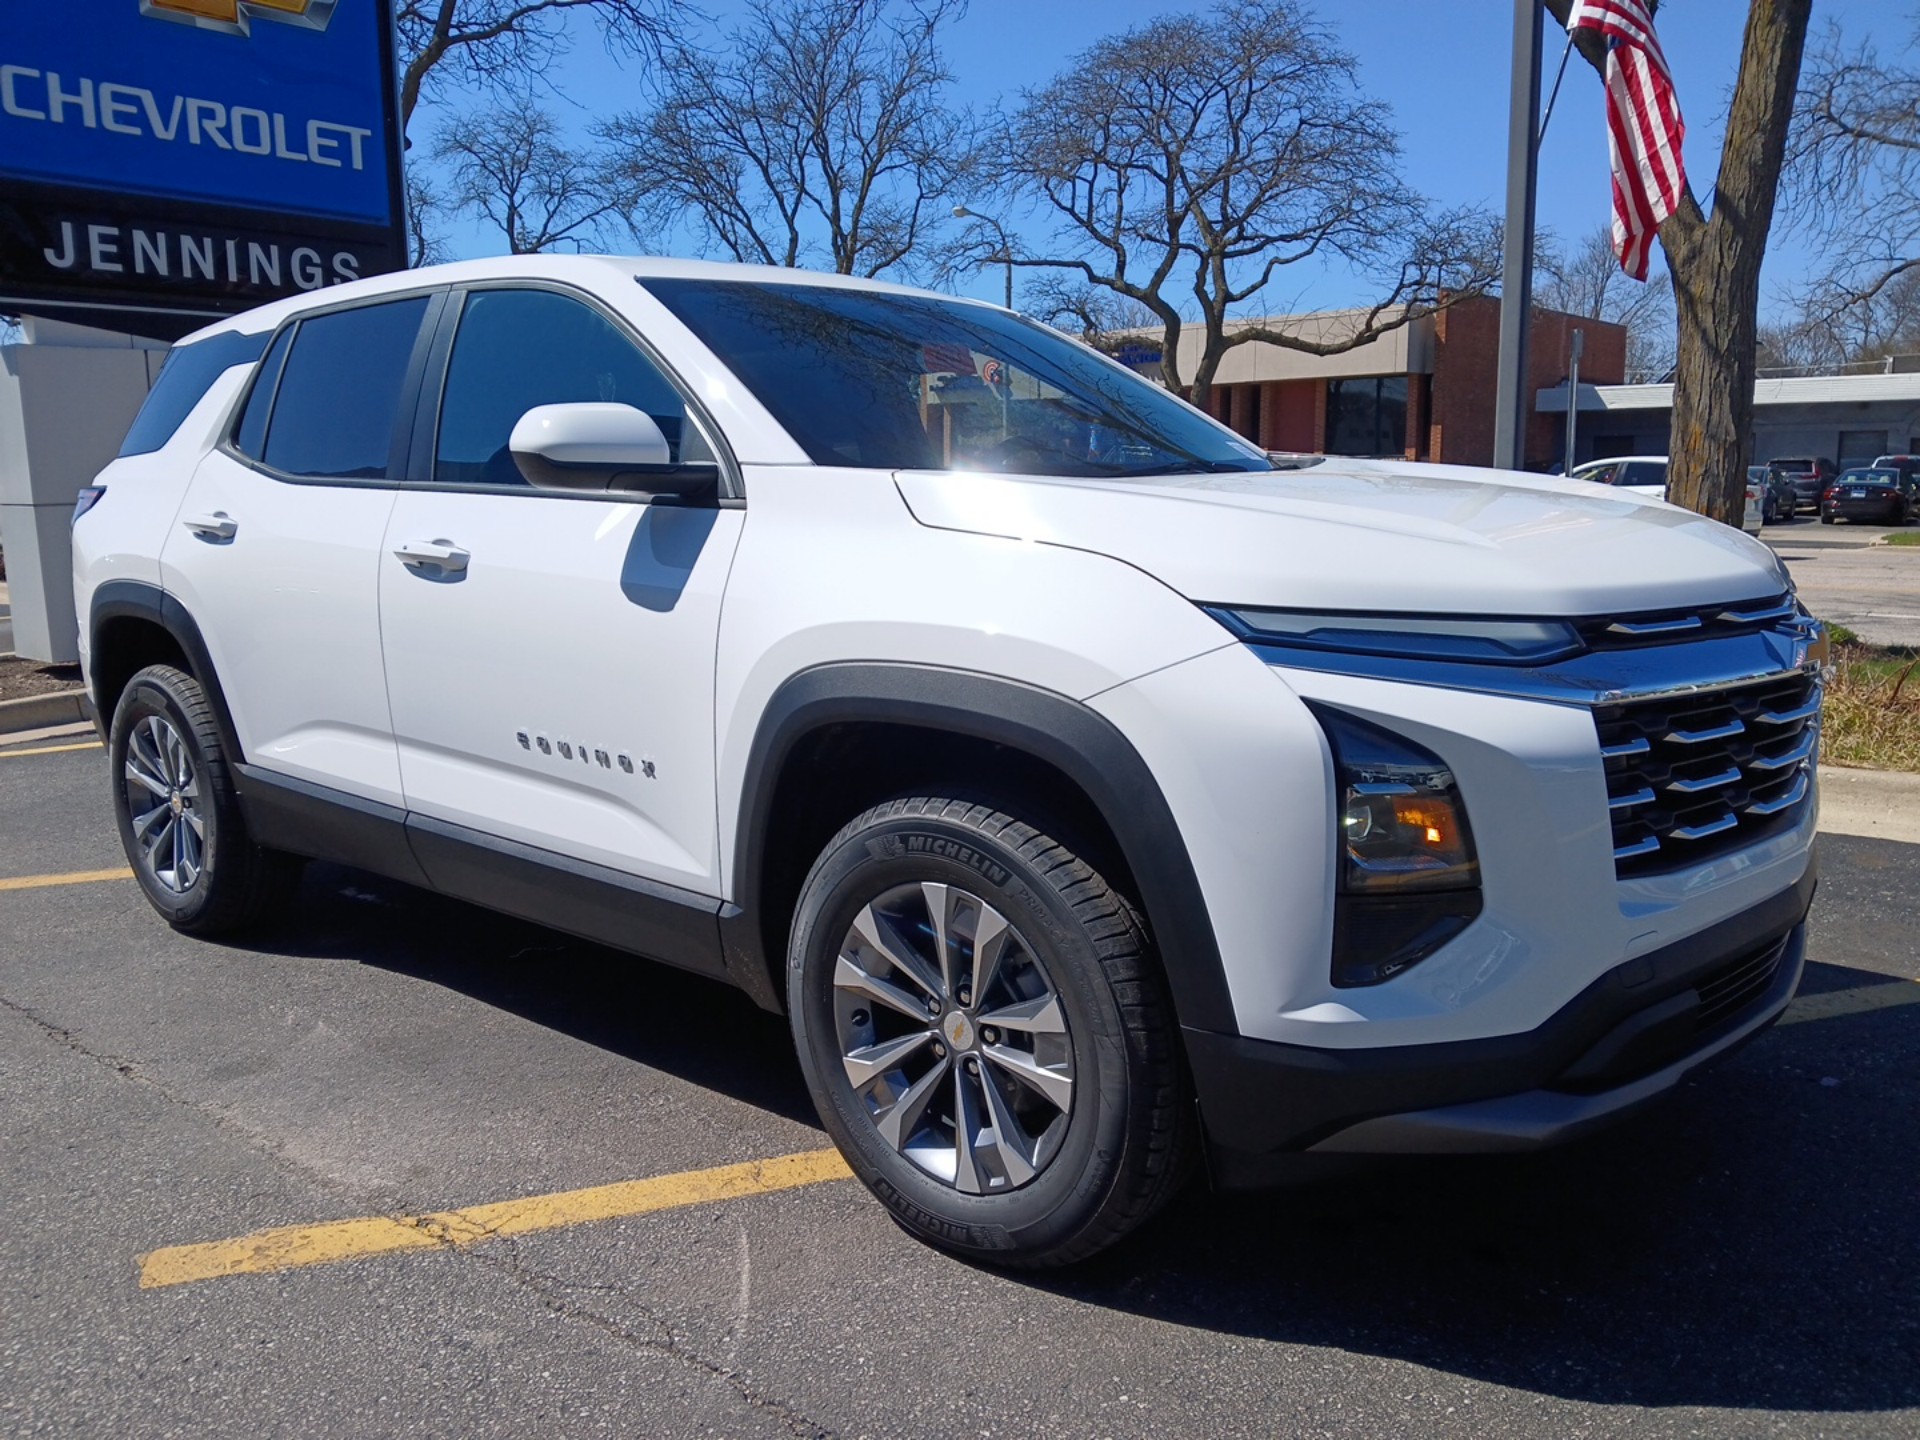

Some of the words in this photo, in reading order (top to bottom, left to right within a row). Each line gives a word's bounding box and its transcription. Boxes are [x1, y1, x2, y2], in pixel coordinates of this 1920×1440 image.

[1, 63, 371, 170] CHEVROLET
[43, 221, 360, 290] JENNINGS
[516, 731, 657, 780] EQUINOX
[907, 836, 1005, 883] MICHELIN
[877, 1178, 969, 1242] MICHELIN
